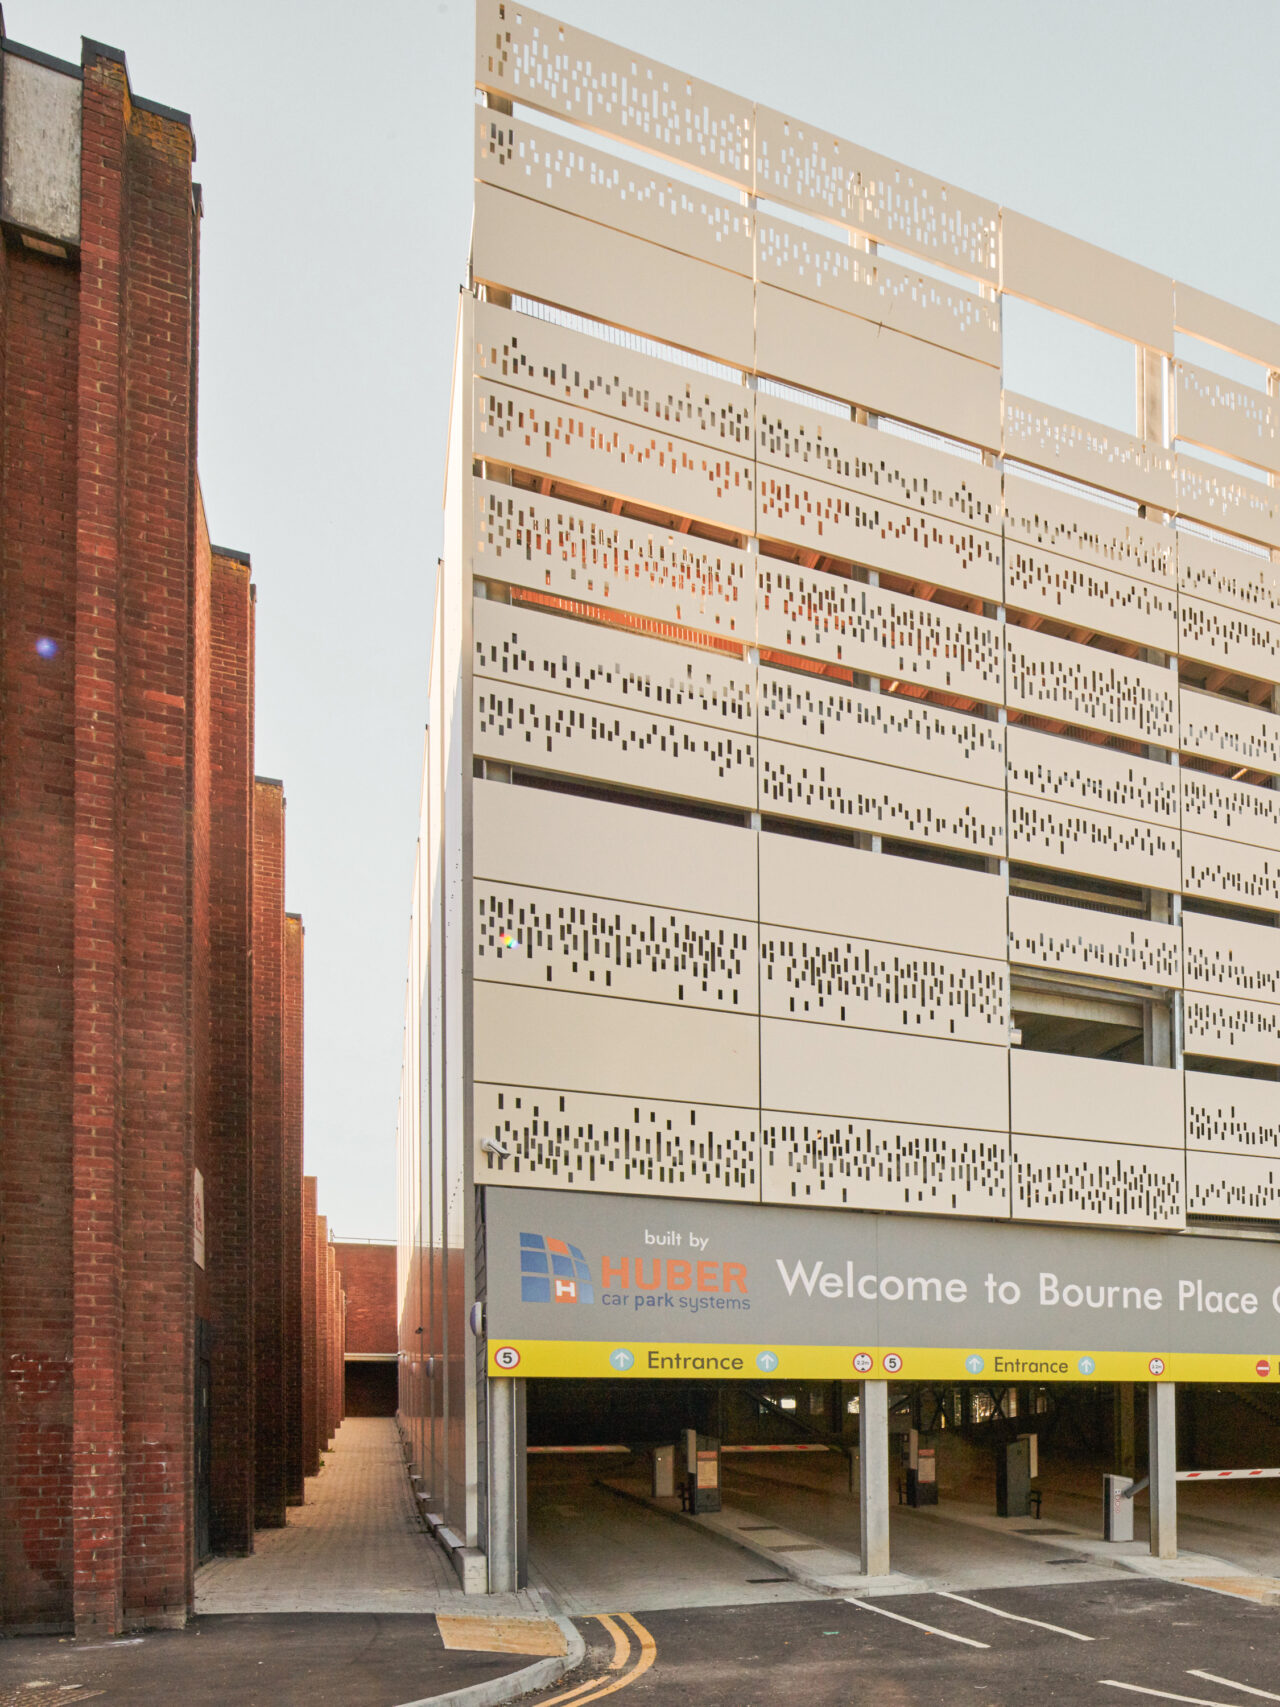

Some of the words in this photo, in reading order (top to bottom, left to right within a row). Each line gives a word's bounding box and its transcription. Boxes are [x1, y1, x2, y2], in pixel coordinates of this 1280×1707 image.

[644, 1229, 682, 1246] built
[689, 1232, 710, 1251] by
[601, 1255, 749, 1294] HUBER
[555, 1279, 577, 1297] H
[775, 1258, 968, 1303] Welcome
[984, 1272, 1021, 1305] to
[1039, 1272, 1163, 1311] Bourne
[1178, 1279, 1259, 1314] Place
[601, 1293, 631, 1306] car
[634, 1292, 675, 1311] park
[679, 1296, 751, 1313] systems
[502, 1351, 513, 1365] 5
[647, 1350, 744, 1371] Entrance
[888, 1357, 898, 1369] 5
[994, 1356, 1069, 1374] Entrance
